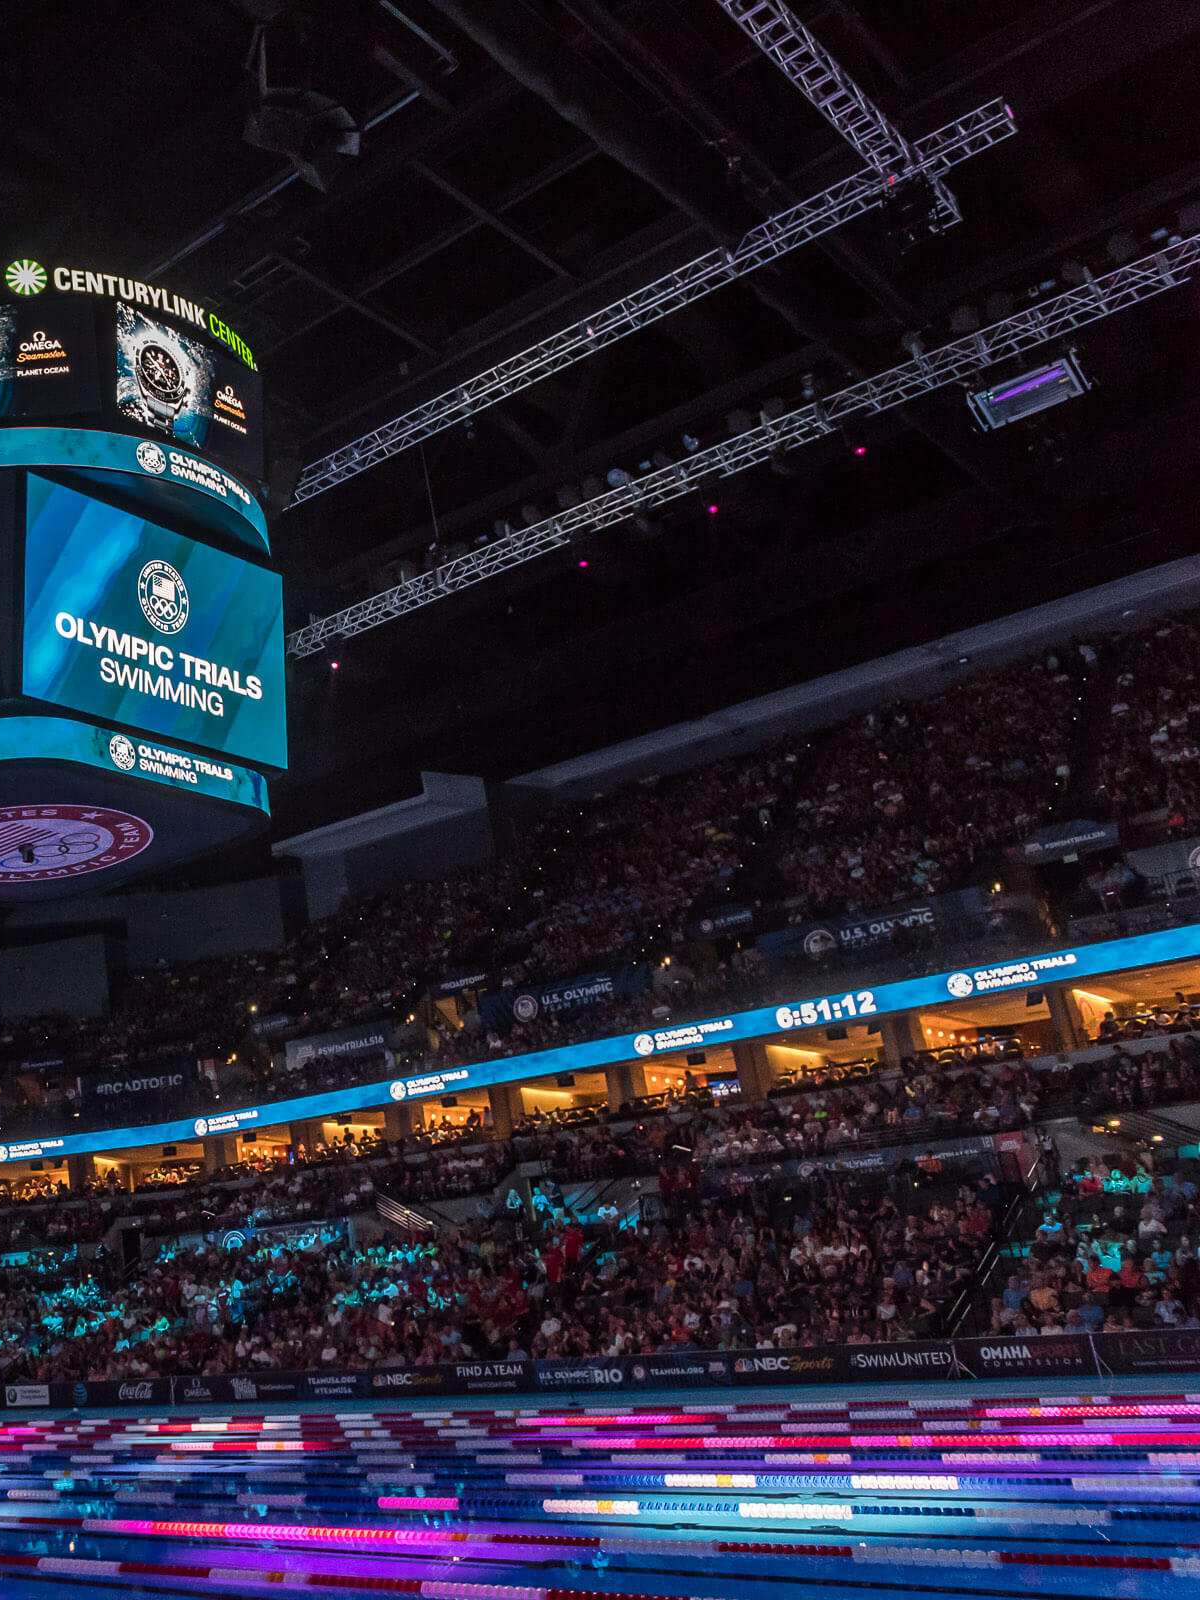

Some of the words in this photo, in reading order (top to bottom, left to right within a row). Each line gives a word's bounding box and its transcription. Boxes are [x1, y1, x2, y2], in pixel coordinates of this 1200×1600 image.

[53, 267, 207, 329] CENTURYLINK
[209, 313, 255, 370] CENTER
[20, 340, 62, 351] OMEGA
[16, 350, 67, 363] Seamaster
[17, 368, 43, 377] PLANET
[43, 366, 69, 374] OCEAN
[216, 390, 243, 410] OMEGA
[169, 451, 221, 482] OLYMPIC
[222, 475, 251, 505] TRIALS
[170, 464, 227, 497] SWIMMING
[55, 611, 174, 671] OLYMPIC
[179, 652, 263, 700] TRIALS
[100, 657, 224, 717] SWIMMING
[138, 745, 191, 769] OLYMPIC
[193, 759, 234, 780] TRIALS
[139, 758, 198, 784] SWIMMING
[114, 822, 140, 850] TEAM
[840, 926, 867, 941] U.S.
[974, 963, 1030, 982] OLYMPIC
[1030, 954, 1077, 972] TRIALS
[976, 971, 1038, 991] SWIMMING
[541, 993, 562, 1006] U.S.
[563, 981, 615, 1000] OLYMPIC
[775, 991, 877, 1029] 6:51:12
[318, 1035, 384, 1055] #SWIMTRIALS16
[979, 1345, 1032, 1360] OMAHA
[983, 1357, 1084, 1368] COMMISSION
[456, 1366, 483, 1377] FIND
[485, 1366, 492, 1376] A
[493, 1364, 523, 1376] TEAM
[650, 1367, 705, 1377] TEAMUSA.ORG
[753, 1357, 790, 1372] NBC
[788, 1355, 834, 1373] Sports
[308, 1376, 357, 1385] TEAMUSA.ORG
[387, 1373, 412, 1386] NBC
[538, 1372, 553, 1380] U.S.
[555, 1371, 590, 1380] OLYMPIC
[594, 1369, 624, 1384] RIO
[184, 1388, 212, 1397] OMEGA
